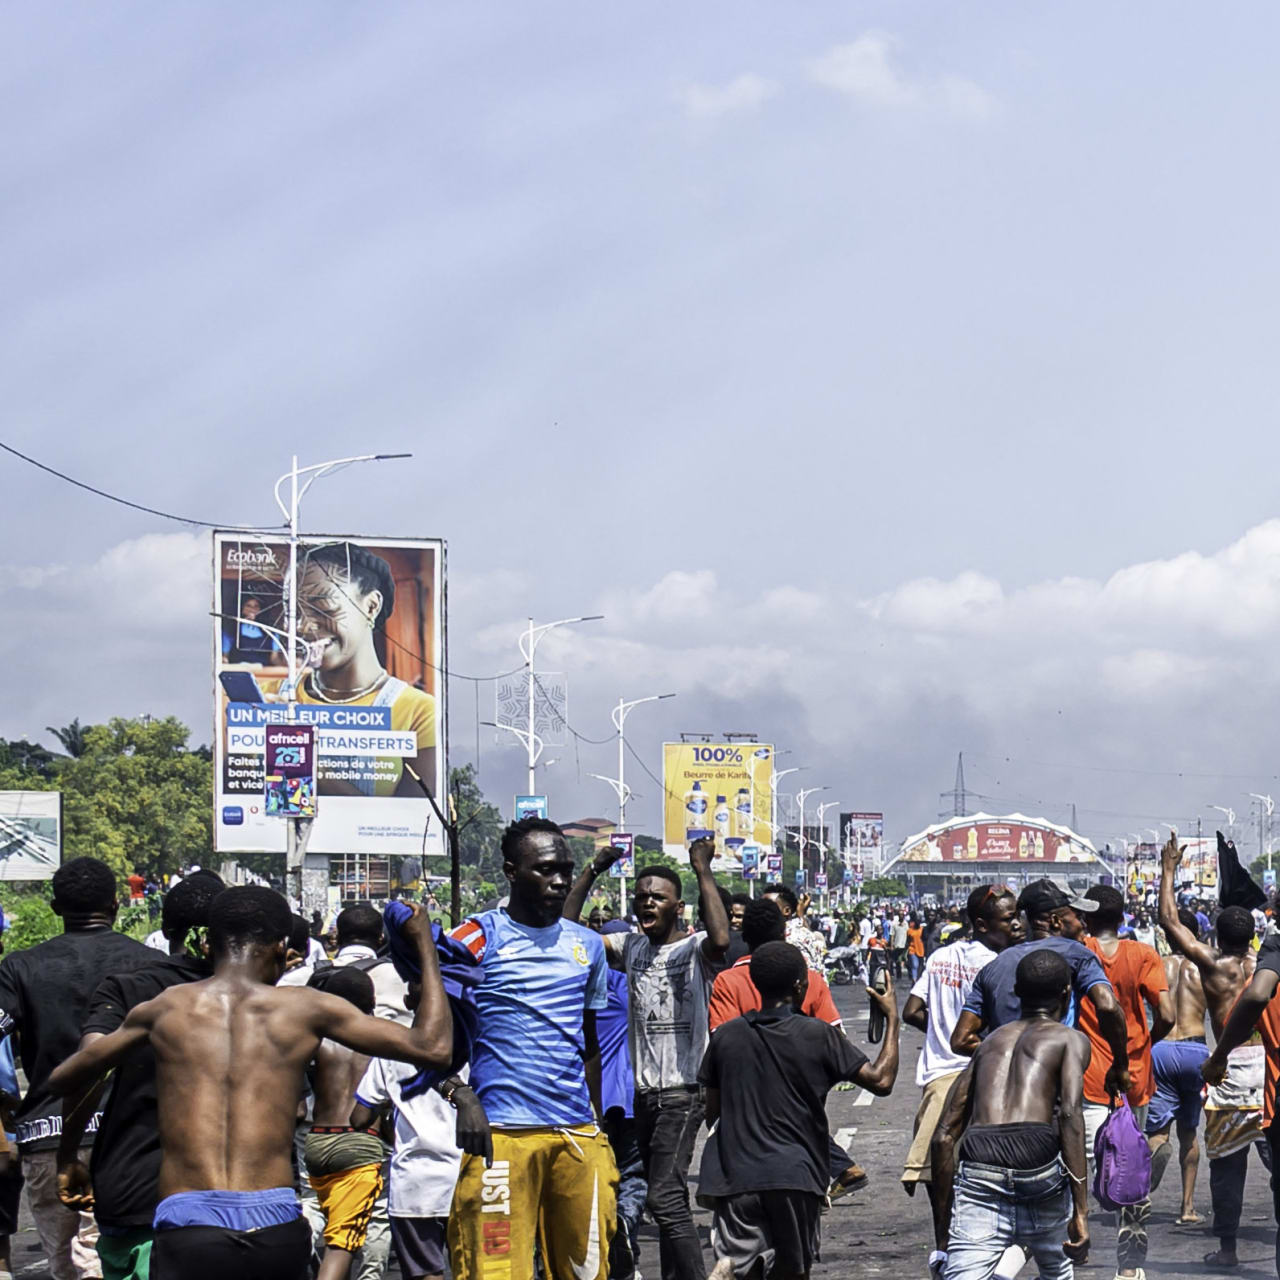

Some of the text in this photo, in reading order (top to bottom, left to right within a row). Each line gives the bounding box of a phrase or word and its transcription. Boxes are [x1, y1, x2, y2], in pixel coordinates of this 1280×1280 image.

[227, 549, 276, 563] Ecobank
[230, 709, 385, 726] UN MEILLEUR CHOIX
[231, 734, 414, 751] POU TRANSFERTS
[692, 747, 743, 762] 100%
[228, 756, 394, 770] Faites ctions de votre
[325, 770, 361, 780] mobile
[363, 773, 398, 783] money
[684, 770, 713, 779] Beurre
[715, 770, 726, 779] de
[228, 781, 239, 789] et
[482, 1157, 511, 1215] JUST
[482, 1221, 511, 1256] DO
